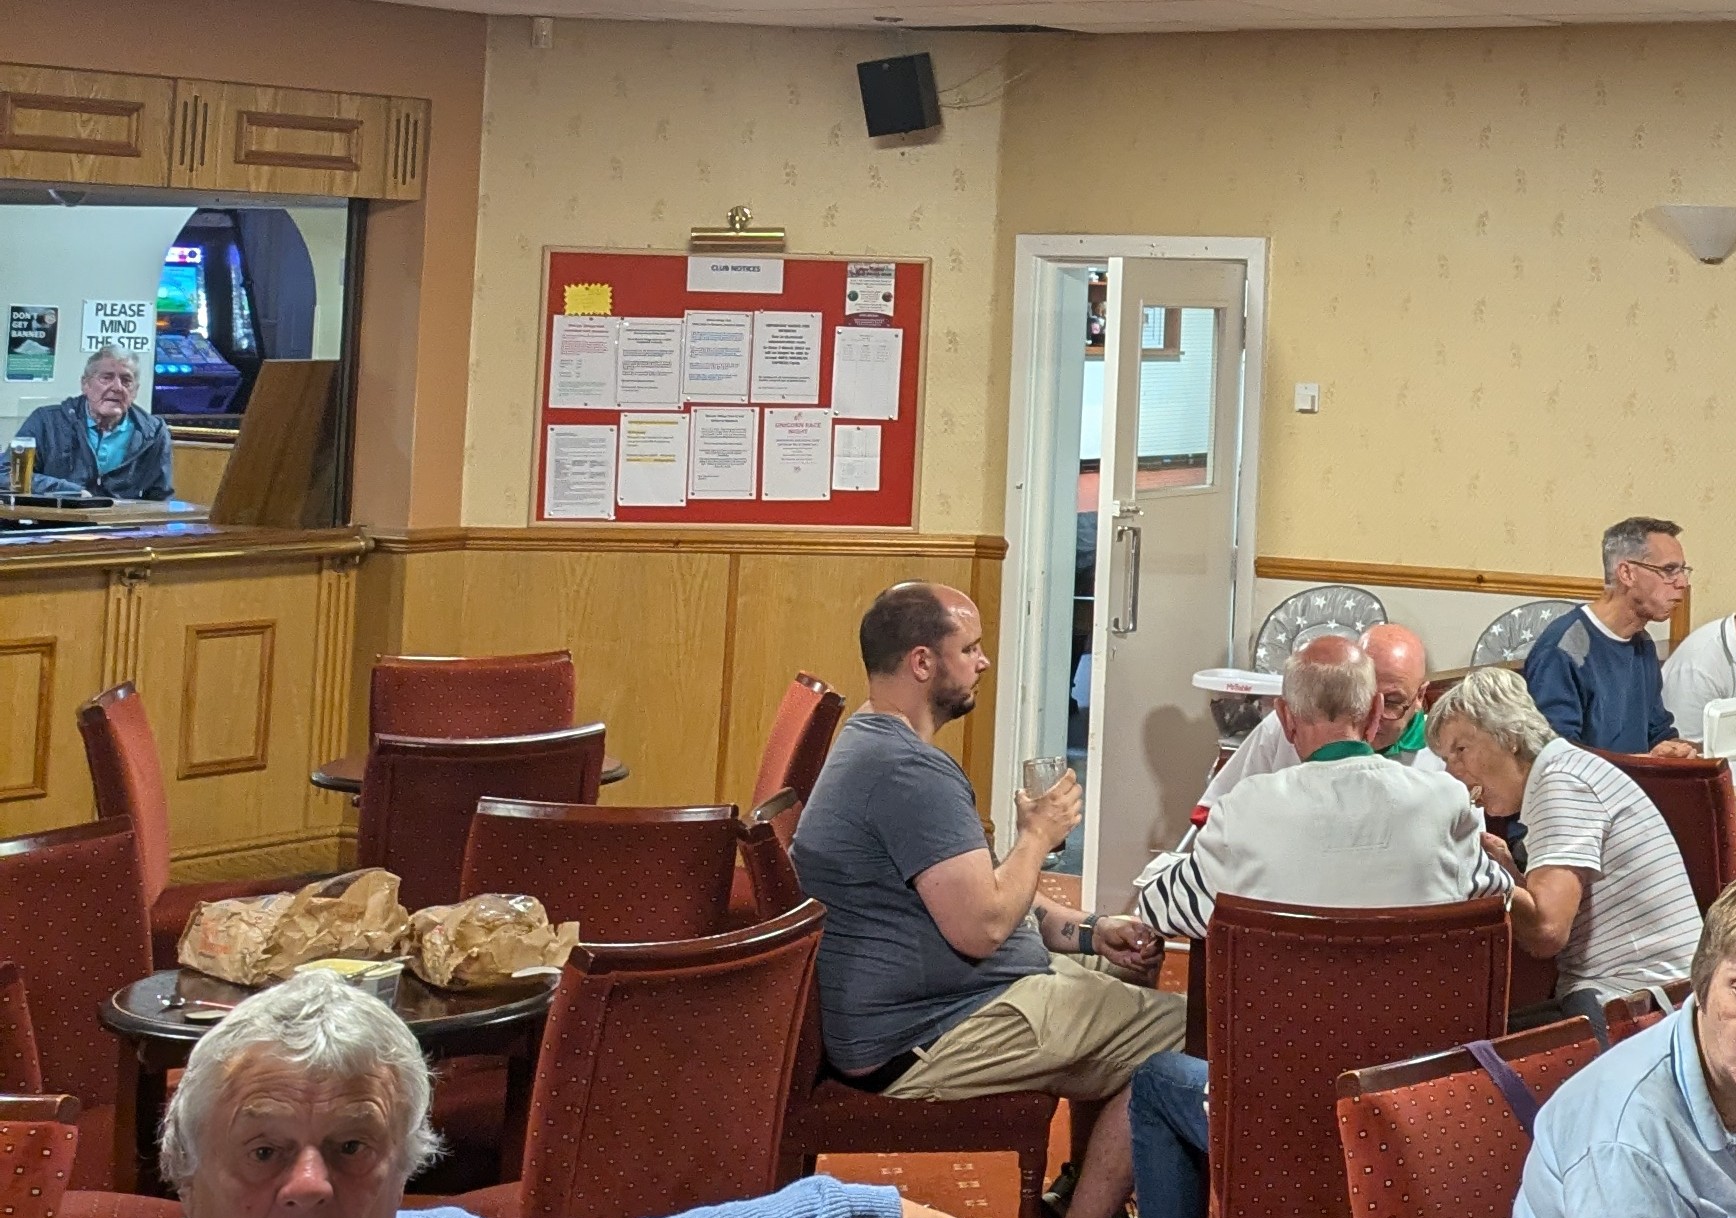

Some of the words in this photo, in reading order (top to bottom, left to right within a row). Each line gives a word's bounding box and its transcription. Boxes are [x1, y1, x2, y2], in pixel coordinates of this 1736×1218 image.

[710, 264, 730, 272] CLUB
[730, 265, 761, 273] NOTICES
[95, 302, 146, 317] PLEASE
[12, 312, 38, 320] DON'T
[11, 321, 29, 329] GET
[100, 319, 137, 334] MIND
[11, 330, 46, 339] BANNED
[117, 336, 149, 351] STEP
